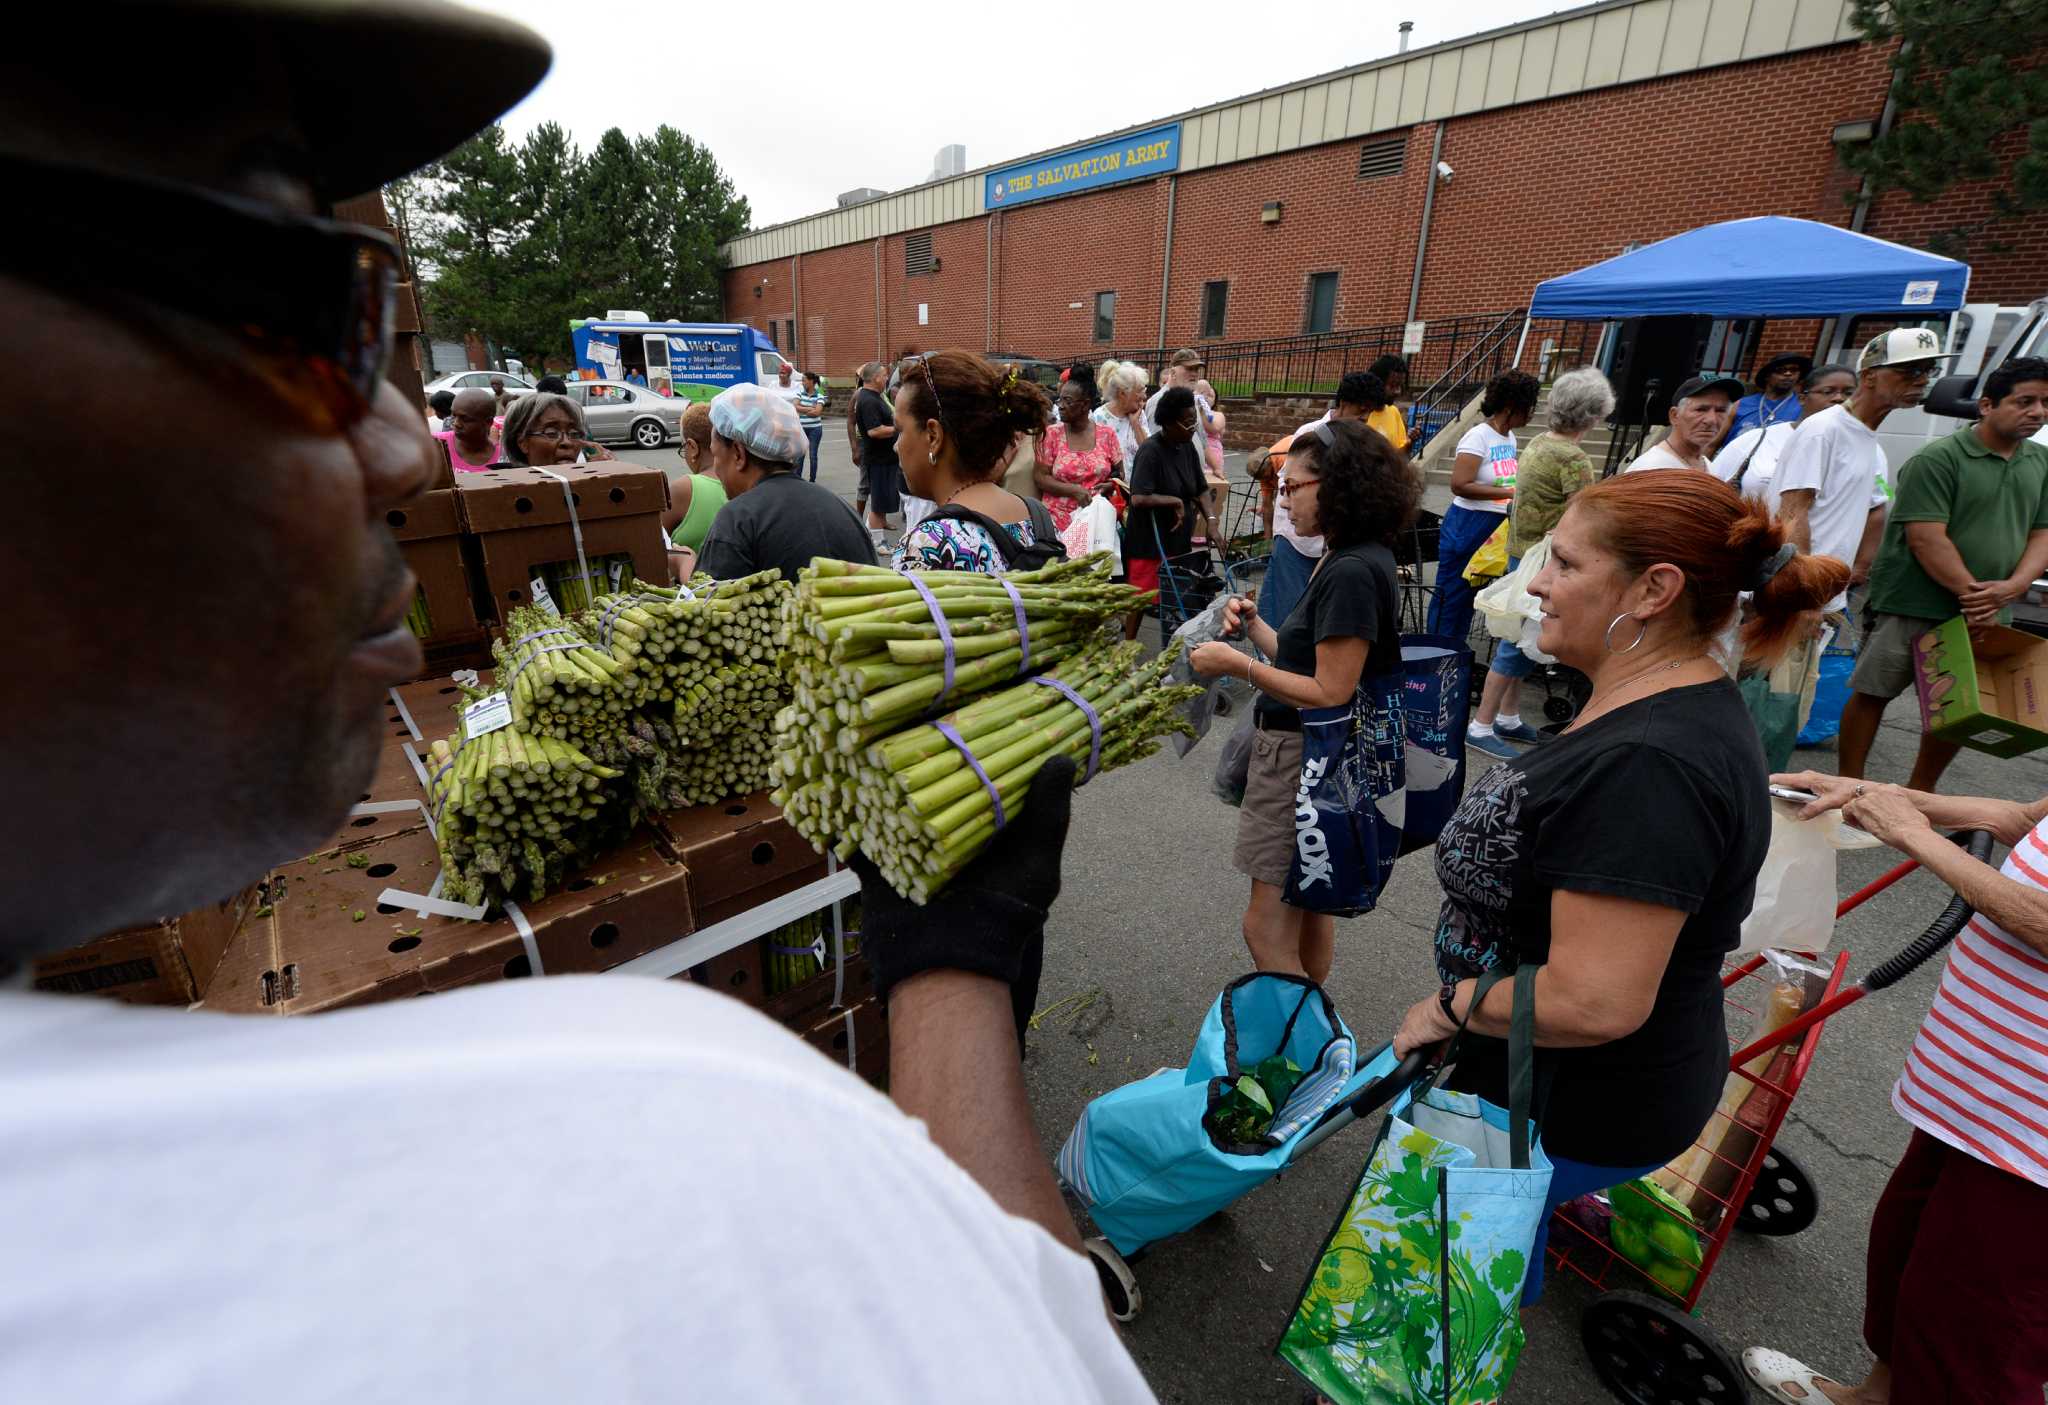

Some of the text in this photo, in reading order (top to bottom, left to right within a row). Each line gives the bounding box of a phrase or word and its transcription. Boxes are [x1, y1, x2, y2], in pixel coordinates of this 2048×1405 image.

[1008, 140, 1171, 194] THE SALVATION ARMY
[1386, 693, 1404, 760] HOTEL
[1442, 848, 1496, 888] PARIS
